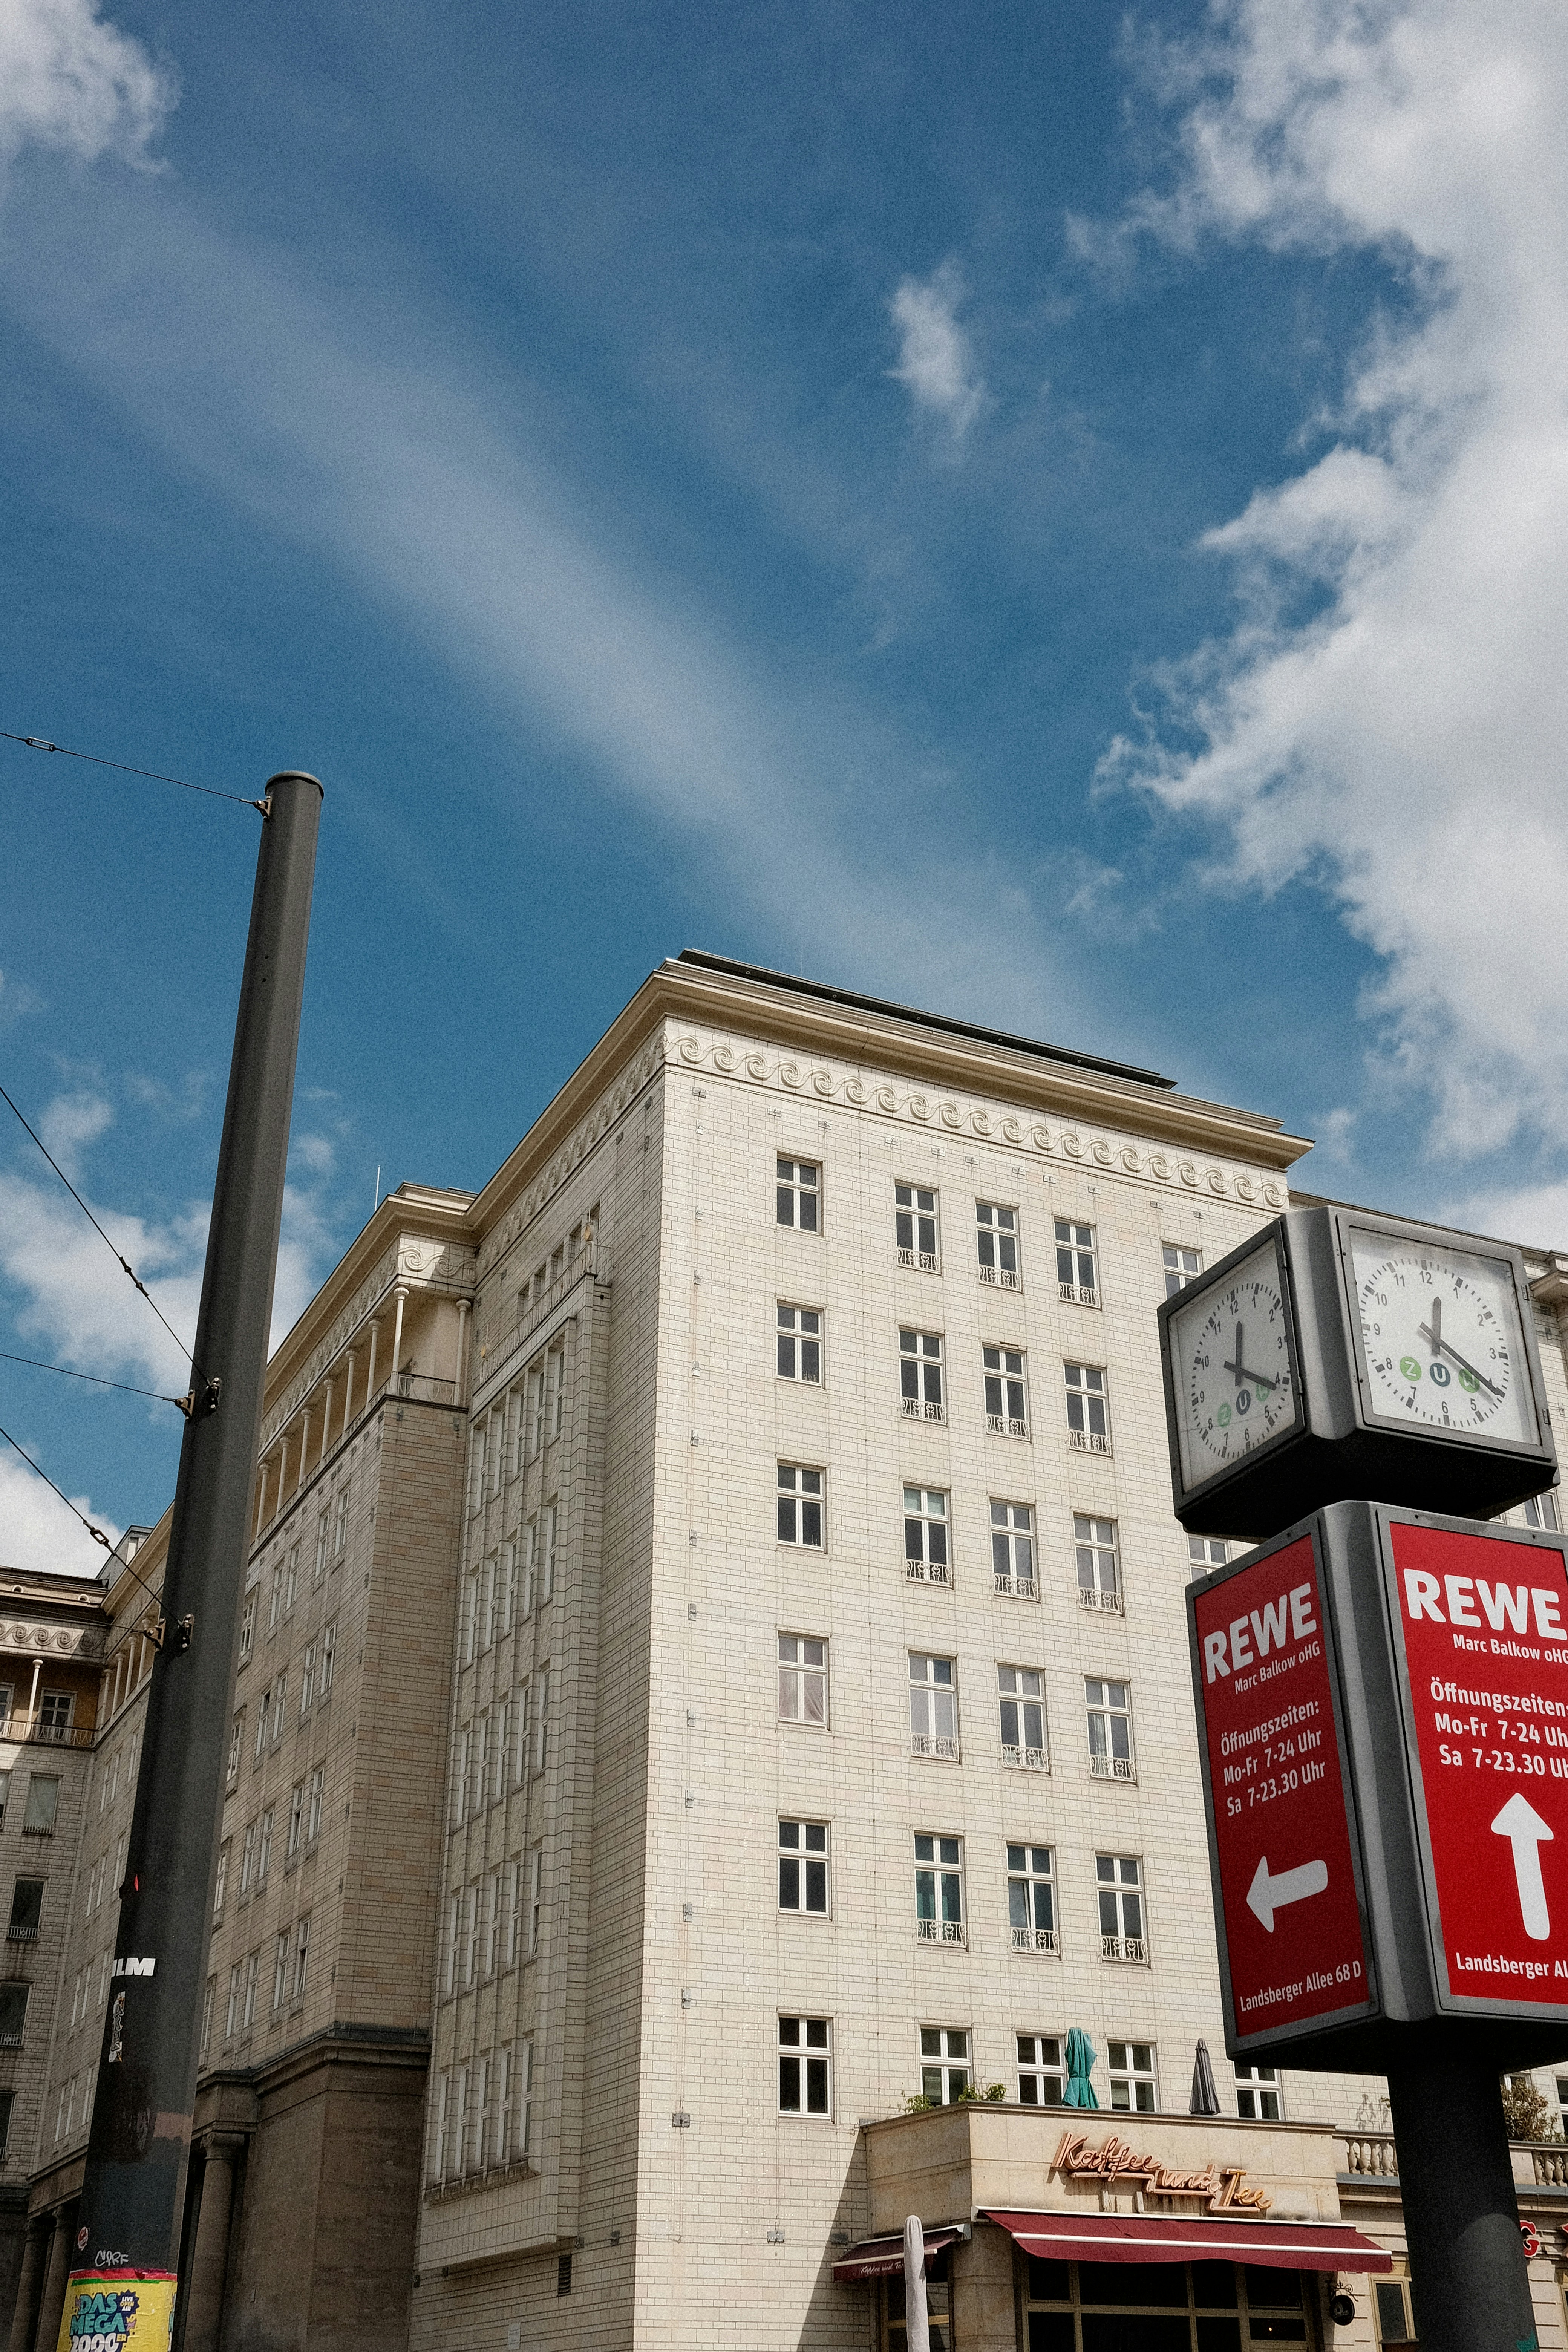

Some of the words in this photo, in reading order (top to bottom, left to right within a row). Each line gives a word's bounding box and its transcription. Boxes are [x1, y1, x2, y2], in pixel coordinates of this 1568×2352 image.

[1394, 1273, 1405, 1287] 11
[1419, 1271, 1432, 1285] 12
[1374, 1292, 1387, 1306] 10
[1453, 1286, 1459, 1299] 1
[1229, 1300, 1239, 1315] 12
[1251, 1295, 1256, 1308] 1
[1269, 1309, 1275, 1323] 2
[1477, 1314, 1484, 1327] 2
[1213, 1321, 1221, 1335] 11
[1373, 1323, 1381, 1335] 9
[1277, 1336, 1282, 1349] 3
[1489, 1347, 1496, 1360] 3
[1200, 1355, 1209, 1370] 10
[1386, 1357, 1393, 1370] 8
[1405, 1361, 1417, 1377] Z
[1433, 1366, 1447, 1383] U
[1199, 1390, 1205, 1403] 9
[1410, 1386, 1417, 1399] 7
[1238, 1393, 1247, 1409] U
[1441, 1401, 1449, 1414] 6
[1470, 1398, 1477, 1411] 5
[1264, 1405, 1269, 1419] 5
[1208, 1418, 1213, 1430] 8
[1223, 1432, 1228, 1446] 7
[1244, 1428, 1250, 1441] 6
[1403, 1568, 1567, 1641] REWE
[1204, 1582, 1317, 1684] REWE
[1452, 1633, 1488, 1653] Marc
[1490, 1638, 1540, 1660] Balkow
[1234, 1674, 1258, 1695] Marc
[1259, 1655, 1296, 1683] Balkow
[1298, 1640, 1320, 1664] oHG
[1221, 1701, 1319, 1756] Öffnungszeiten:
[1434, 1712, 1488, 1738] Mo-Fr
[1497, 1720, 1541, 1744] 7-24
[1544, 1726, 1568, 1748] Uh
[1223, 1756, 1258, 1786] Mo-Fr
[1264, 1738, 1295, 1768] 7-24
[1297, 1729, 1321, 1753] Uhr
[1439, 1744, 1463, 1766] Sa
[1472, 1747, 1545, 1776] 7-23.30
[1549, 1757, 1568, 1779] Uh
[1227, 1796, 1242, 1816] Sa
[1247, 1769, 1298, 1807] 7-23.30
[1301, 1760, 1325, 1785] Uhr
[1456, 1952, 1549, 1979] Landsberger
[1240, 1981, 1303, 2012] Landsberger
[1306, 1971, 1334, 1992] Allee
[1335, 1963, 1351, 1983] 68
[1352, 1960, 1361, 1978] D
[1051, 2132, 1162, 2182] Kaffee
[1156, 2164, 1222, 2192] und
[1219, 2168, 1273, 2210] Tee
[78, 2293, 117, 2315] DAS
[70, 2312, 126, 2336] MEGA
